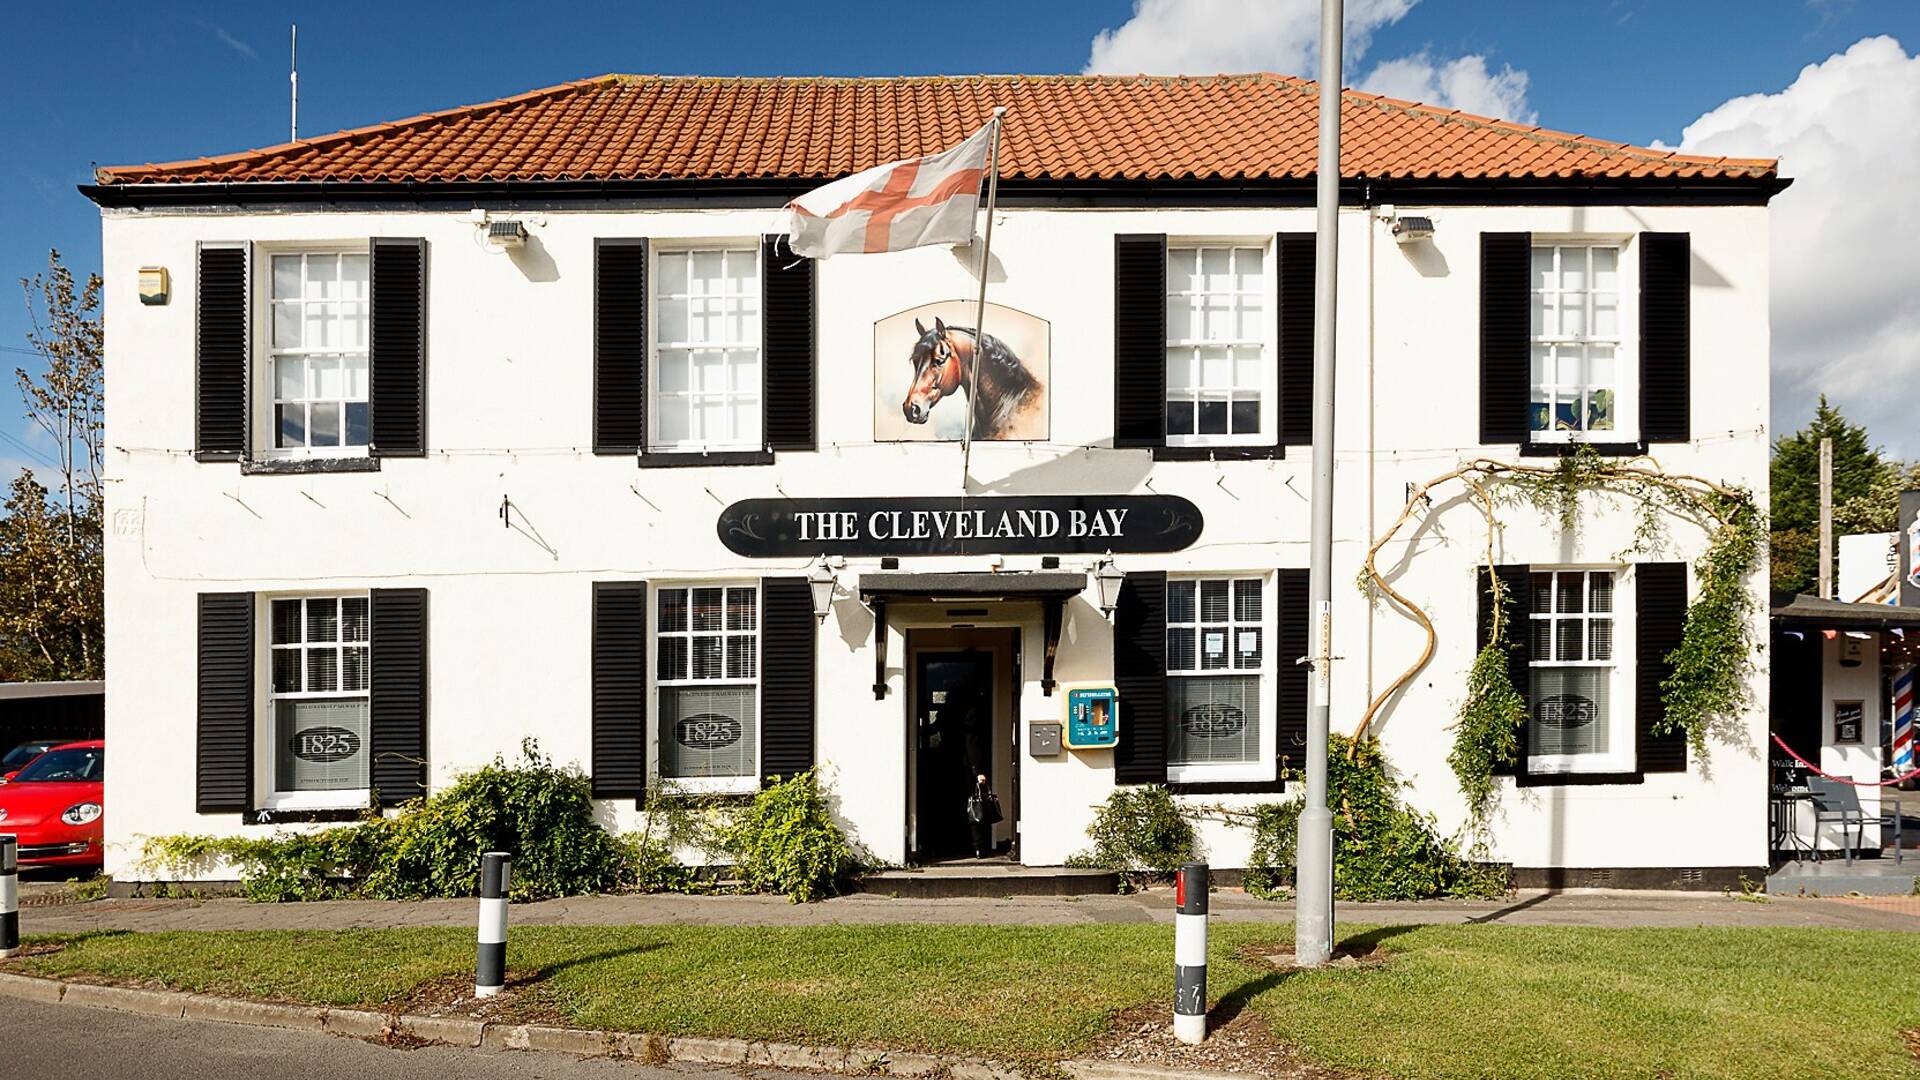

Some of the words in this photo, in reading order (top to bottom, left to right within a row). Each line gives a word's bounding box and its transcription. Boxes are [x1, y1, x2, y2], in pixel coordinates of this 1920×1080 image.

[794, 511, 859, 541] THE
[867, 509, 1060, 541] CLEVELAND
[1067, 507, 1129, 538] BAY
[1192, 711, 1238, 730] 1825
[1545, 703, 1589, 720] 1825
[685, 723, 732, 741] 1825
[302, 735, 350, 754] 1825
[1772, 760, 1794, 768] Walk
